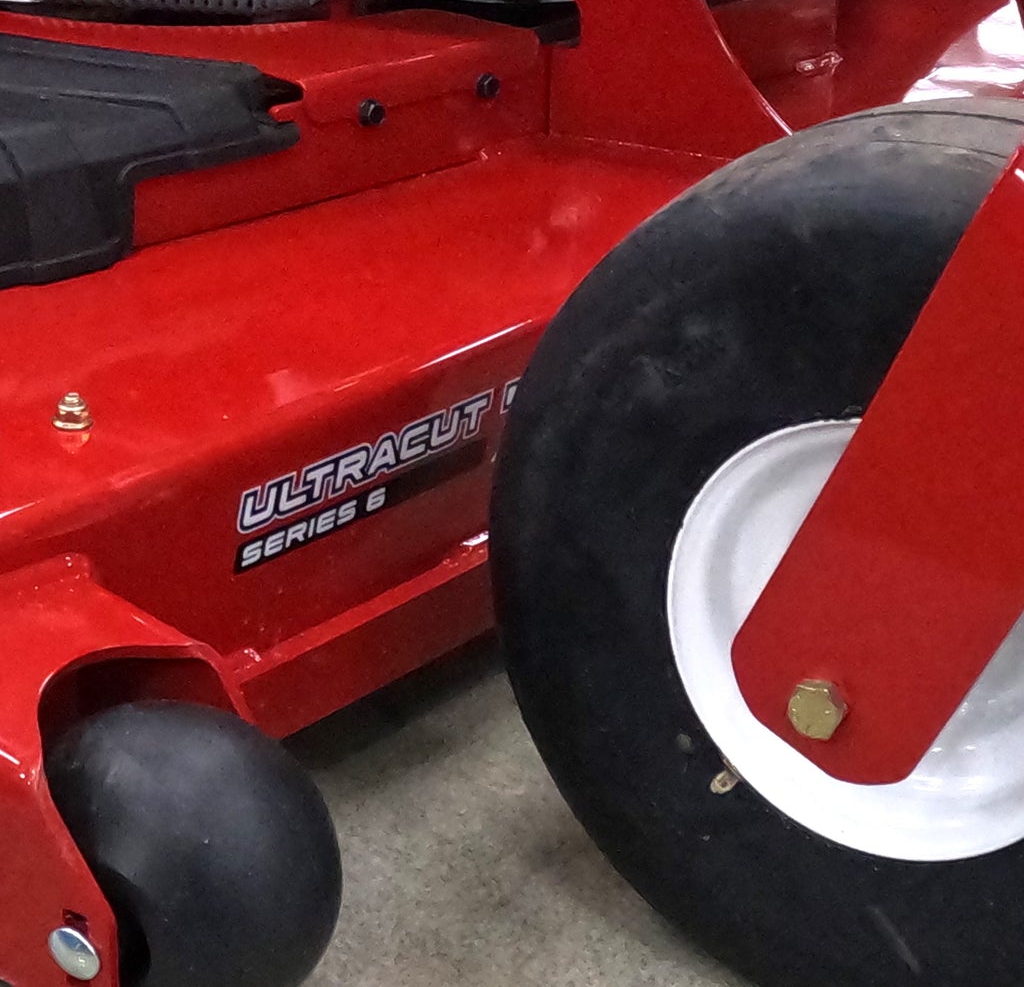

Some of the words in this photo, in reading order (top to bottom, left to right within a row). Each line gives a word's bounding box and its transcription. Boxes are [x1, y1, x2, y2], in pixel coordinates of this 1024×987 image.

[238, 390, 493, 533] ULTRACUT
[240, 499, 358, 568] SERIES
[364, 487, 387, 513] 6
